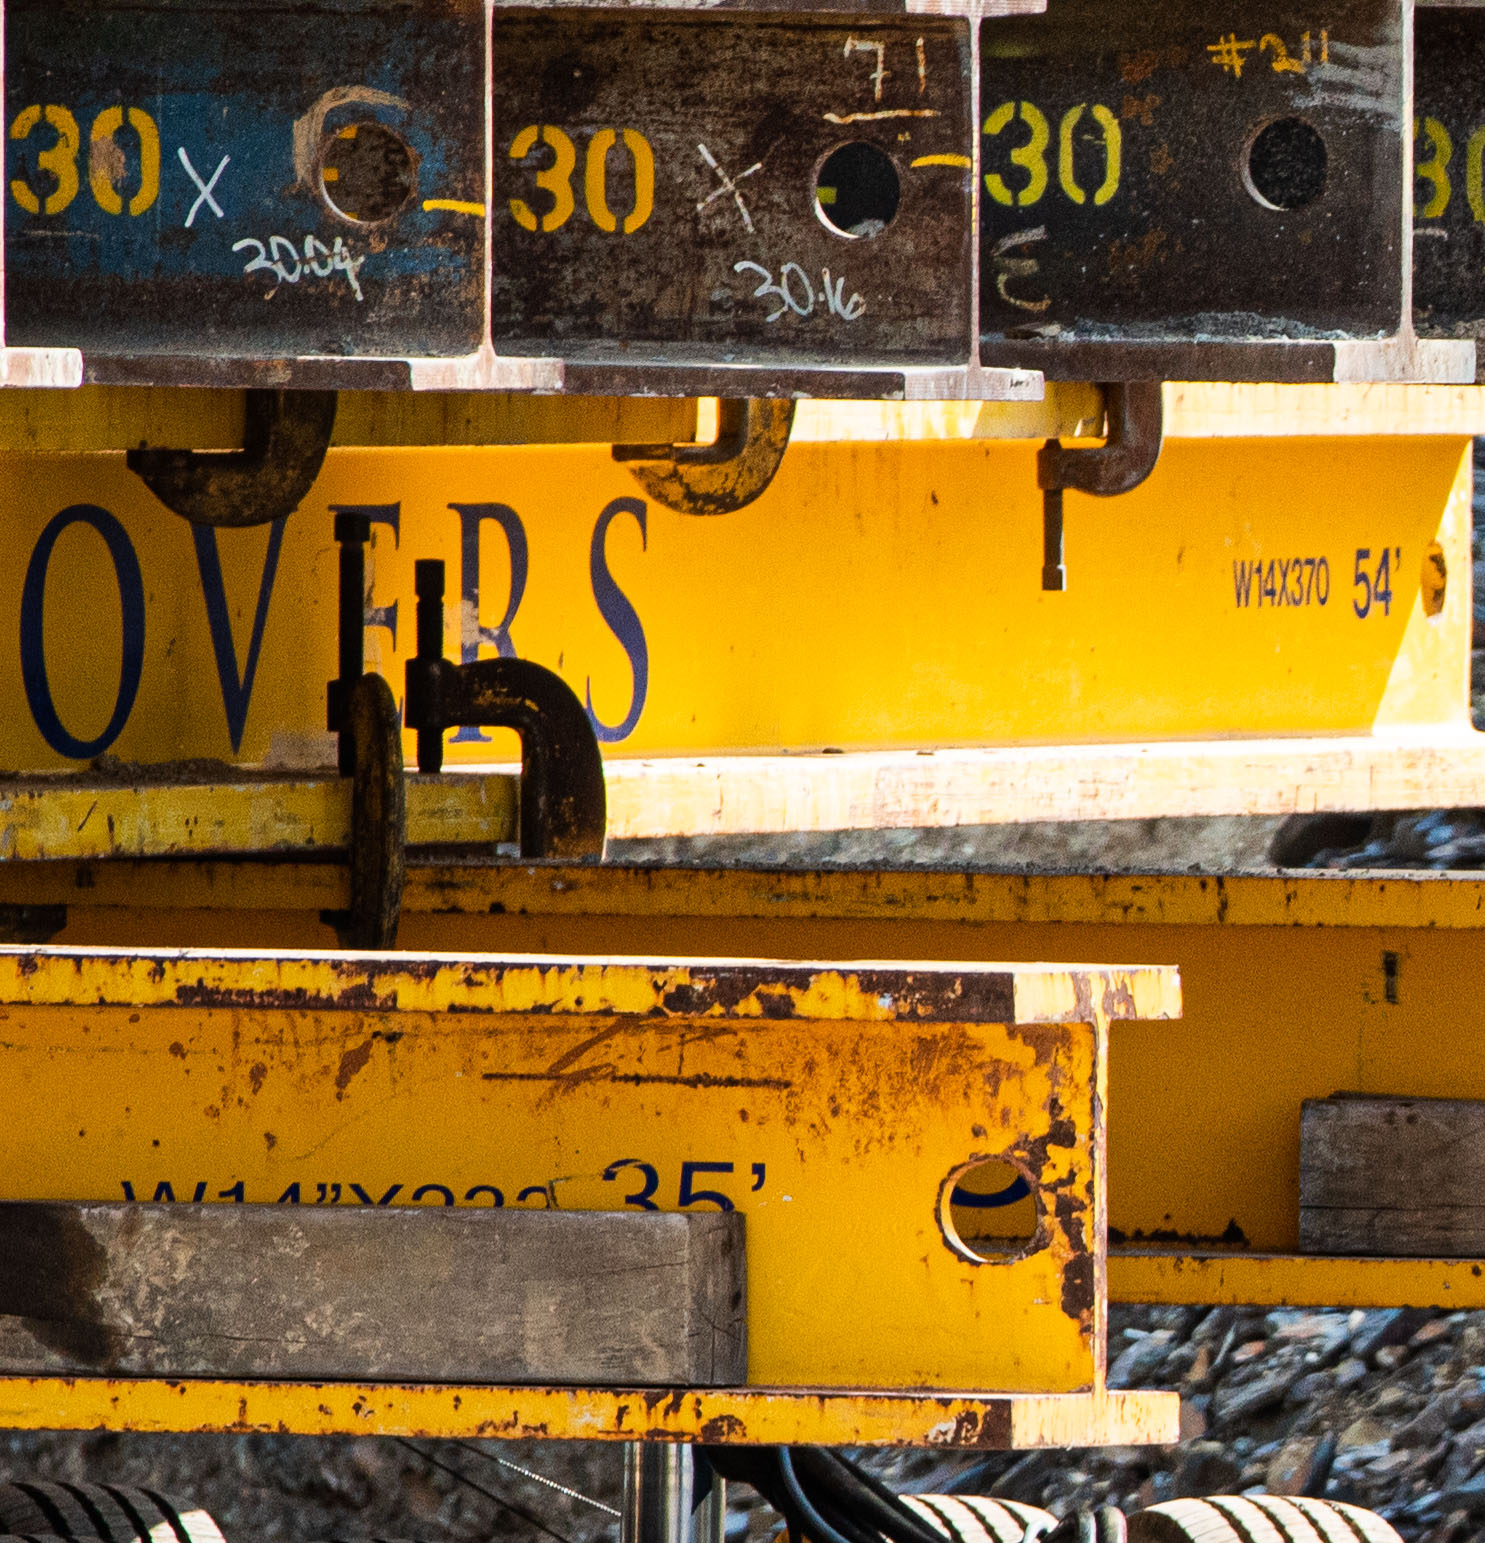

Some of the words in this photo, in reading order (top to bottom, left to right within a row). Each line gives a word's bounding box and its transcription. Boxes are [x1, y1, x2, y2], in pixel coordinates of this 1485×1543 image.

[8, 104, 161, 216] 30
[508, 124, 656, 234] 30
[983, 101, 1122, 206] 30
[1232, 556, 1330, 609] W14X370
